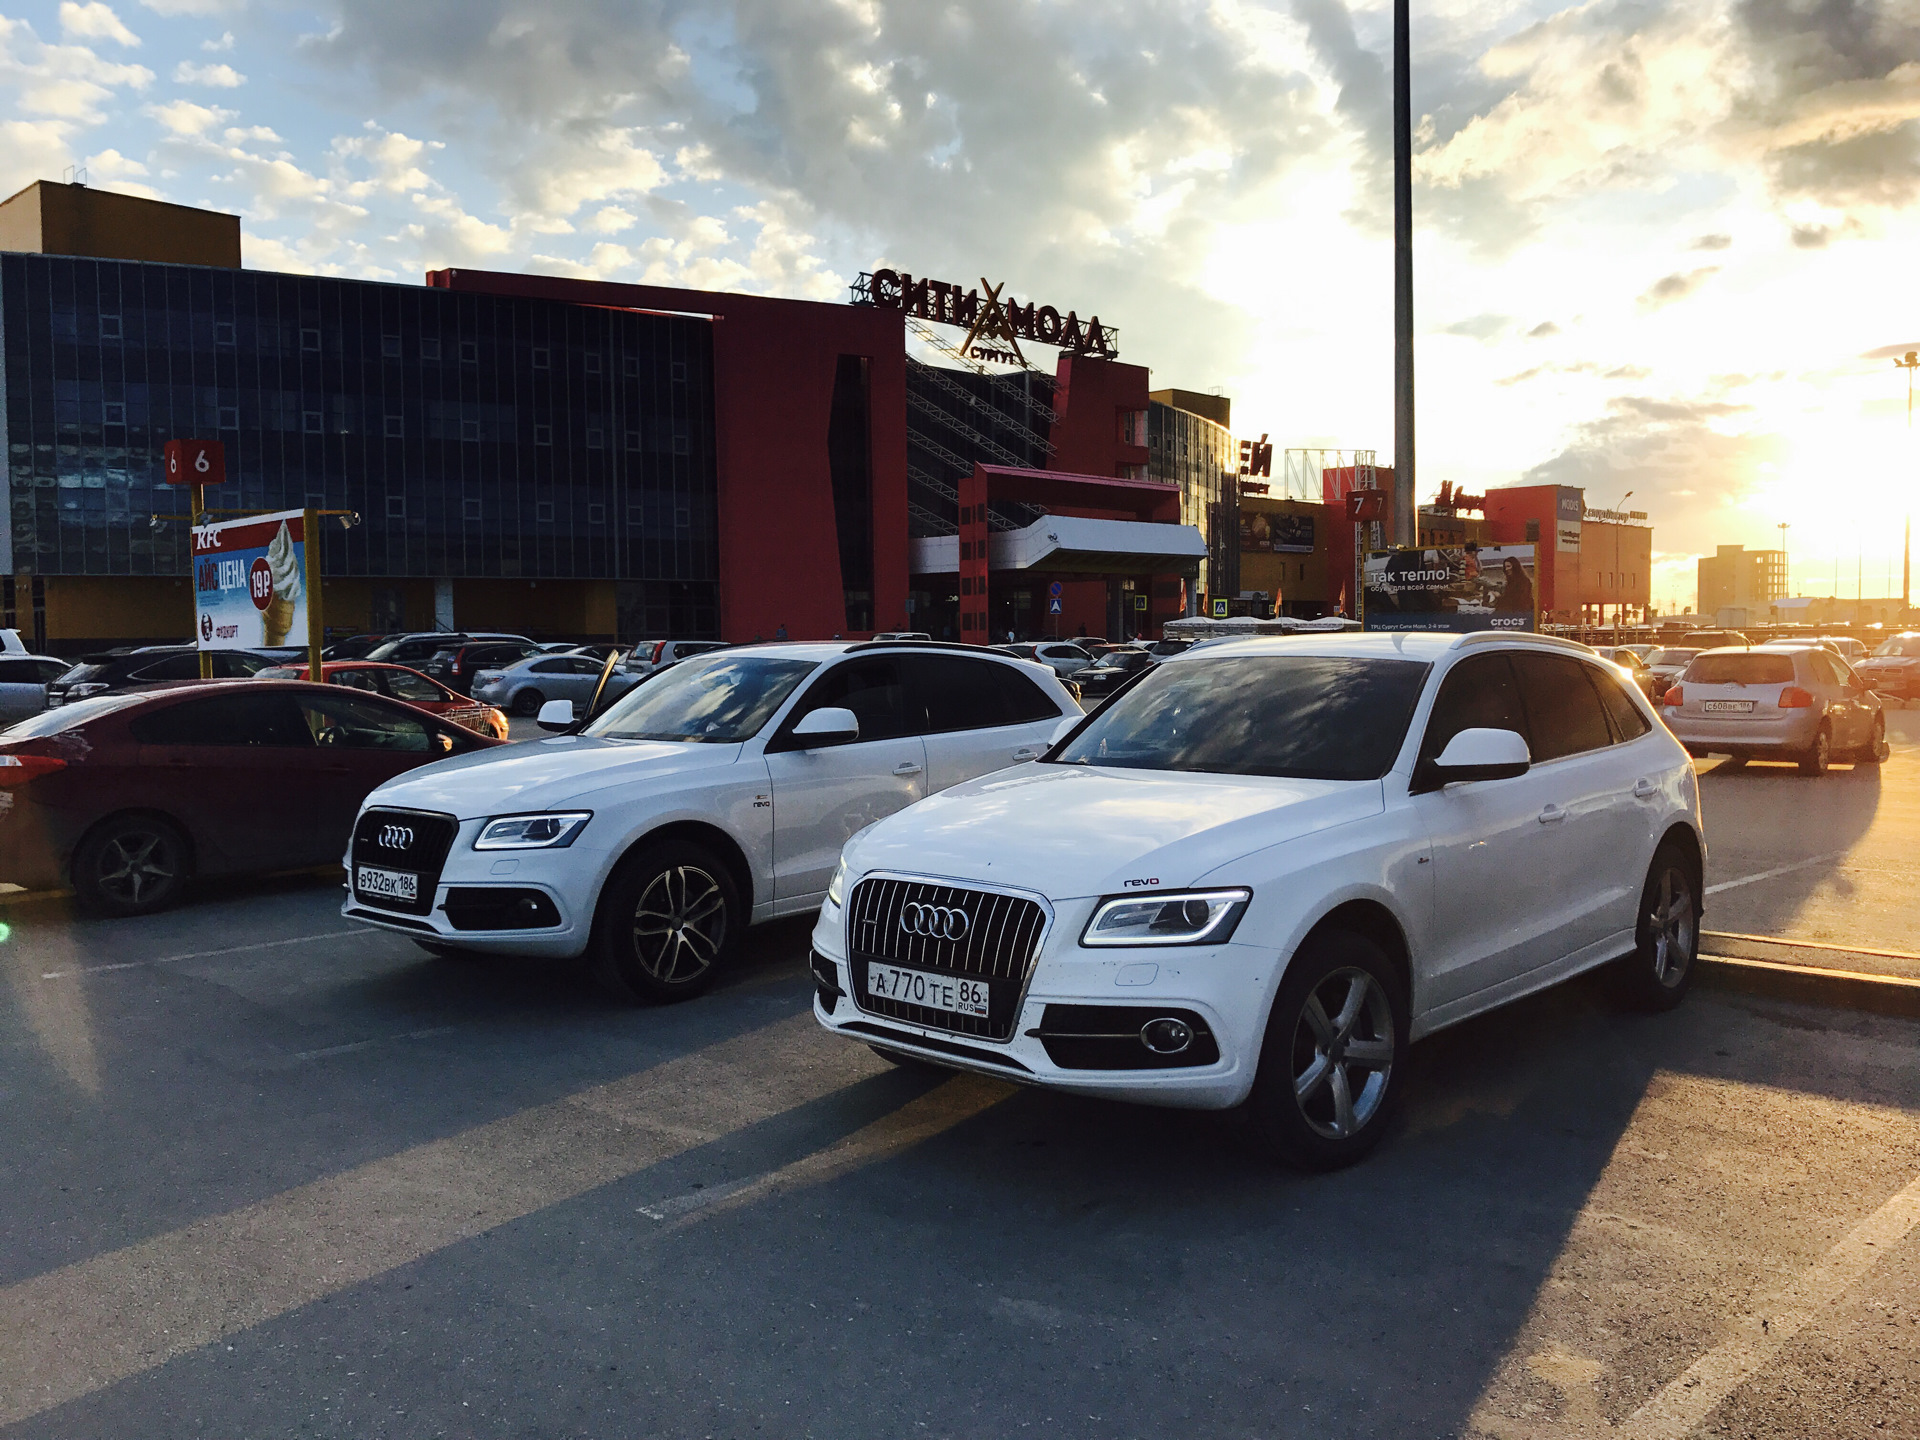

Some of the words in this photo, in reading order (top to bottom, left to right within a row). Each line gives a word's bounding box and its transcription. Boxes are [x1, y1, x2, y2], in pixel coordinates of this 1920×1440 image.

[871, 268, 977, 325] СИТИ
[1008, 297, 1107, 355] МОЛЛ
[970, 346, 1017, 365] СУРГУТ
[170, 450, 177, 474] 6
[194, 449, 210, 473] 6
[1353, 497, 1364, 514] 7
[1377, 497, 1383, 513] 7
[1561, 498, 1579, 511] MODIS
[196, 529, 222, 550] KFC
[199, 557, 218, 592] АЙС
[218, 559, 247, 594] ЦЕНА
[1371, 571, 1395, 582] так
[1400, 567, 1450, 582] тепло!
[1407, 583, 1424, 591] всей
[1490, 617, 1525, 626] crocs
[399, 875, 414, 891] 186
[1123, 877, 1160, 888] revo
[960, 981, 981, 1004] 86
[957, 1002, 974, 1012] RUS
